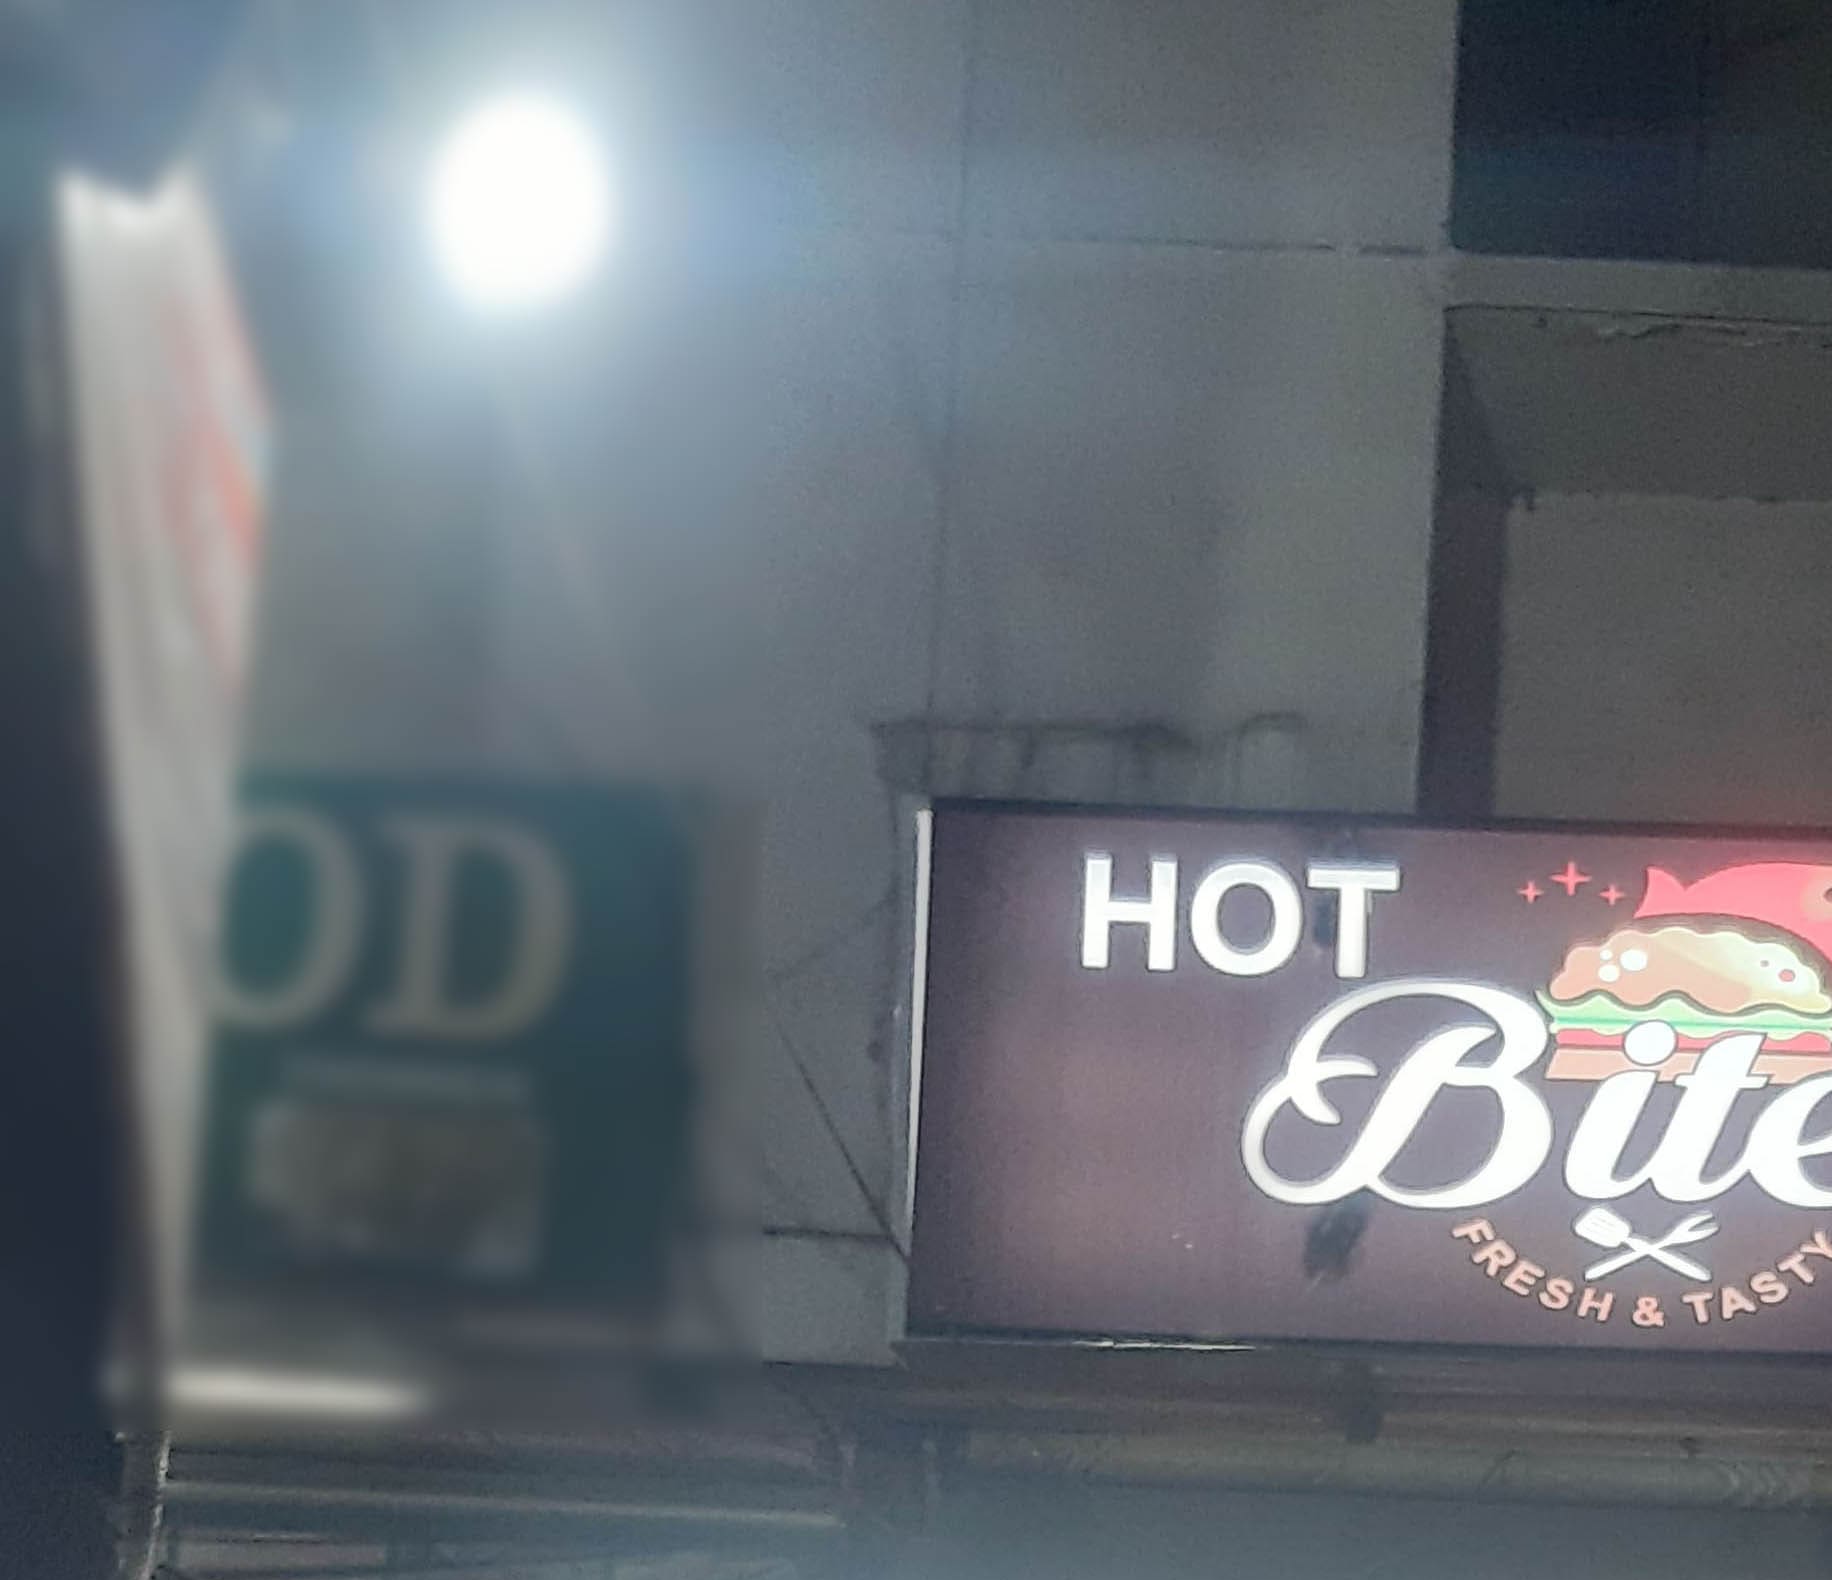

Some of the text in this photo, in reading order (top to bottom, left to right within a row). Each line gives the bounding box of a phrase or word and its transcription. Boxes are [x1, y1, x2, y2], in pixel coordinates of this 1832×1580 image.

[1080, 854, 1400, 979] HOT
[1452, 1217, 1615, 1323] FRESH
[1631, 1295, 1666, 1328] &
